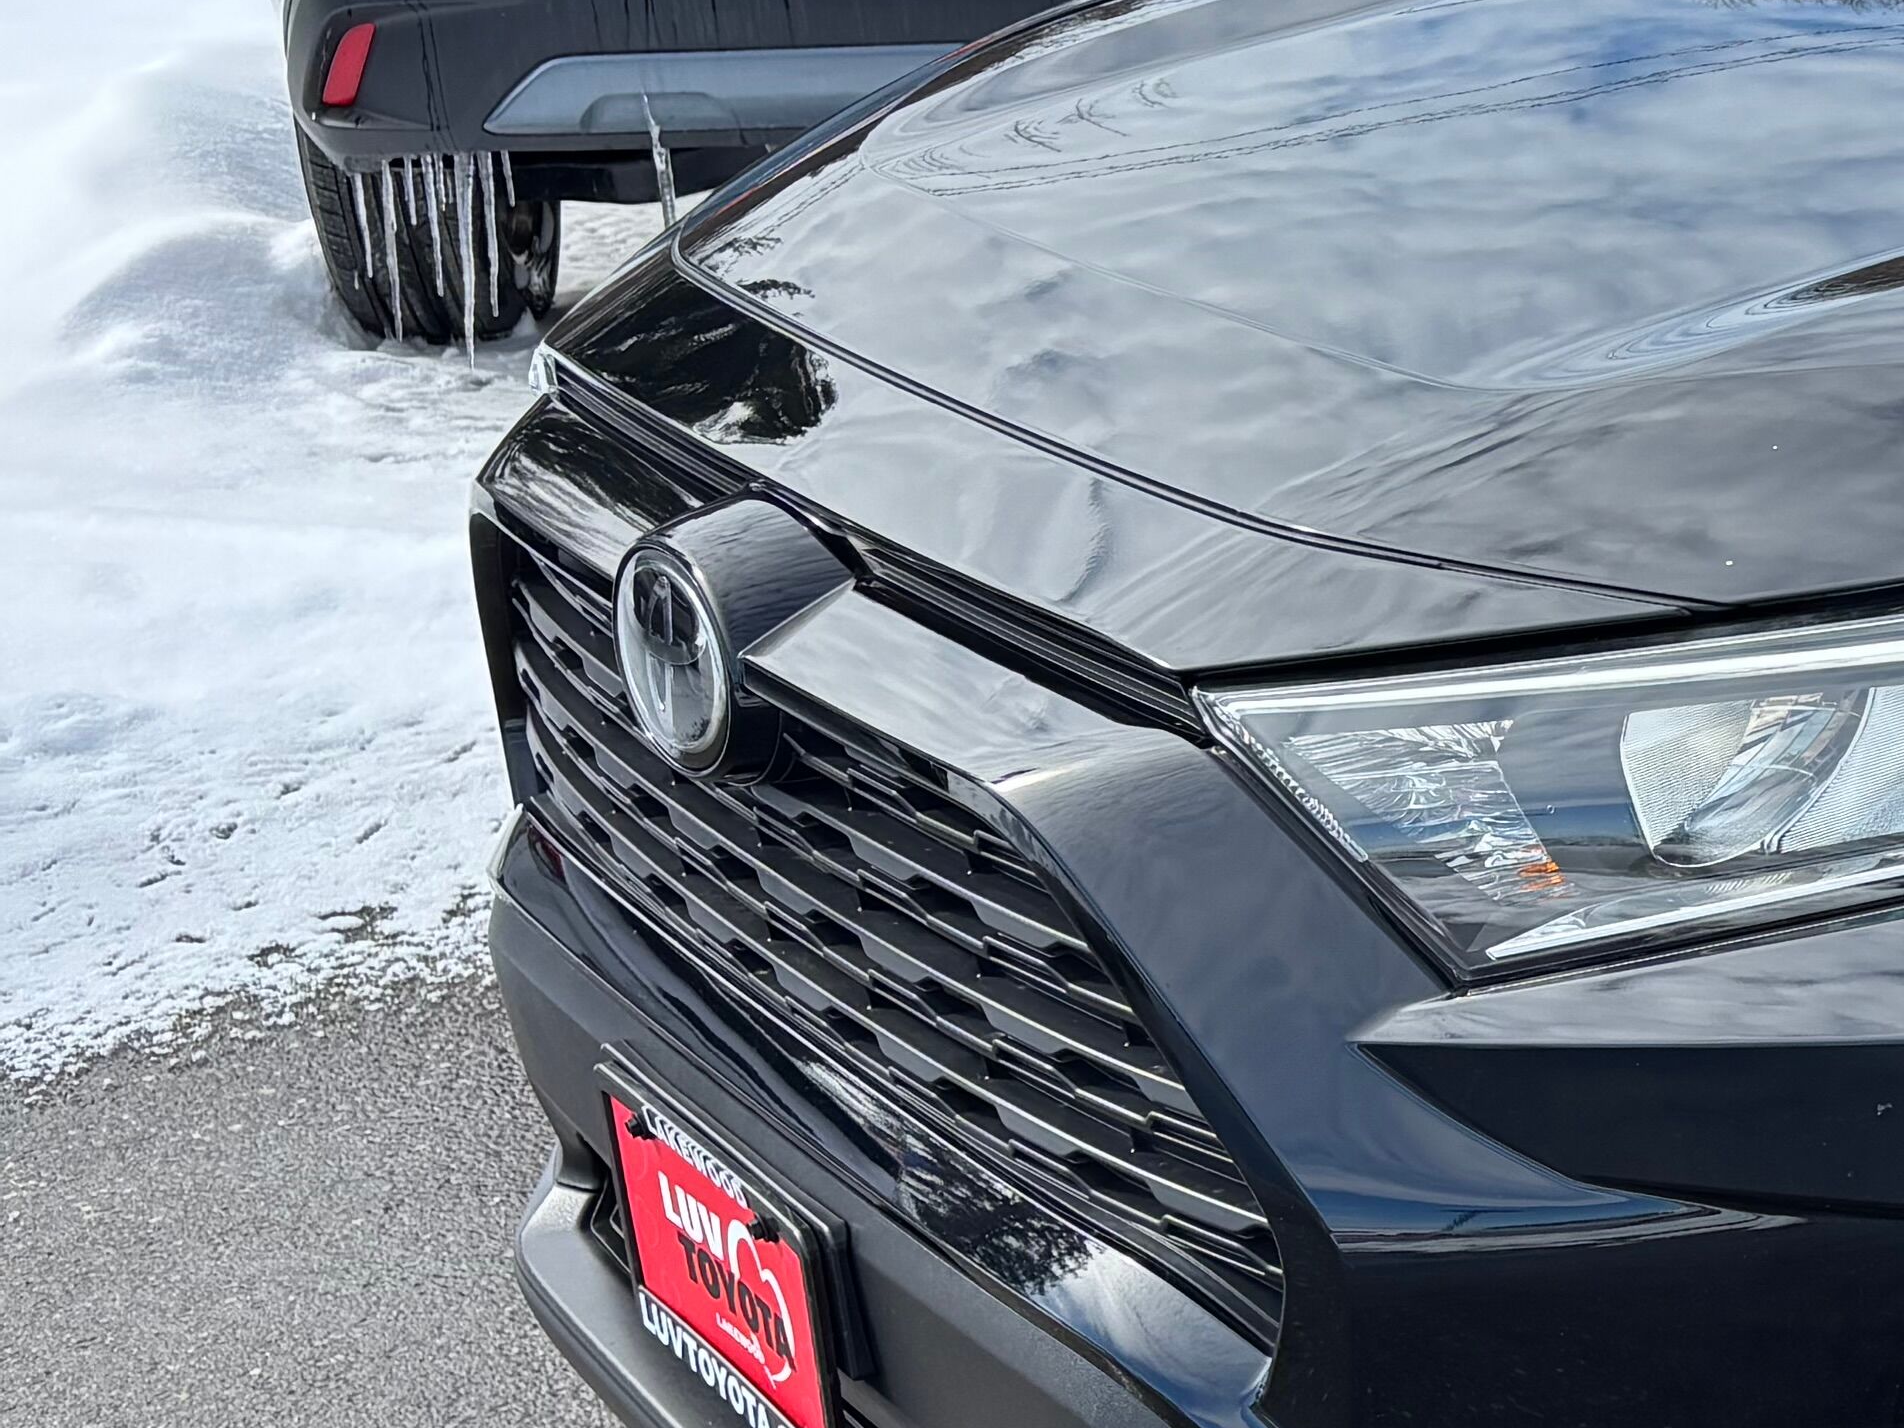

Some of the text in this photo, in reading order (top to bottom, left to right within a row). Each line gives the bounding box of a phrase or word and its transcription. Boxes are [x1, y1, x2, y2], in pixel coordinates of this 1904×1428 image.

[643, 1105, 748, 1209] LAKEWOOD
[657, 1171, 724, 1260] LUV
[679, 1236, 796, 1372] TOYOTA
